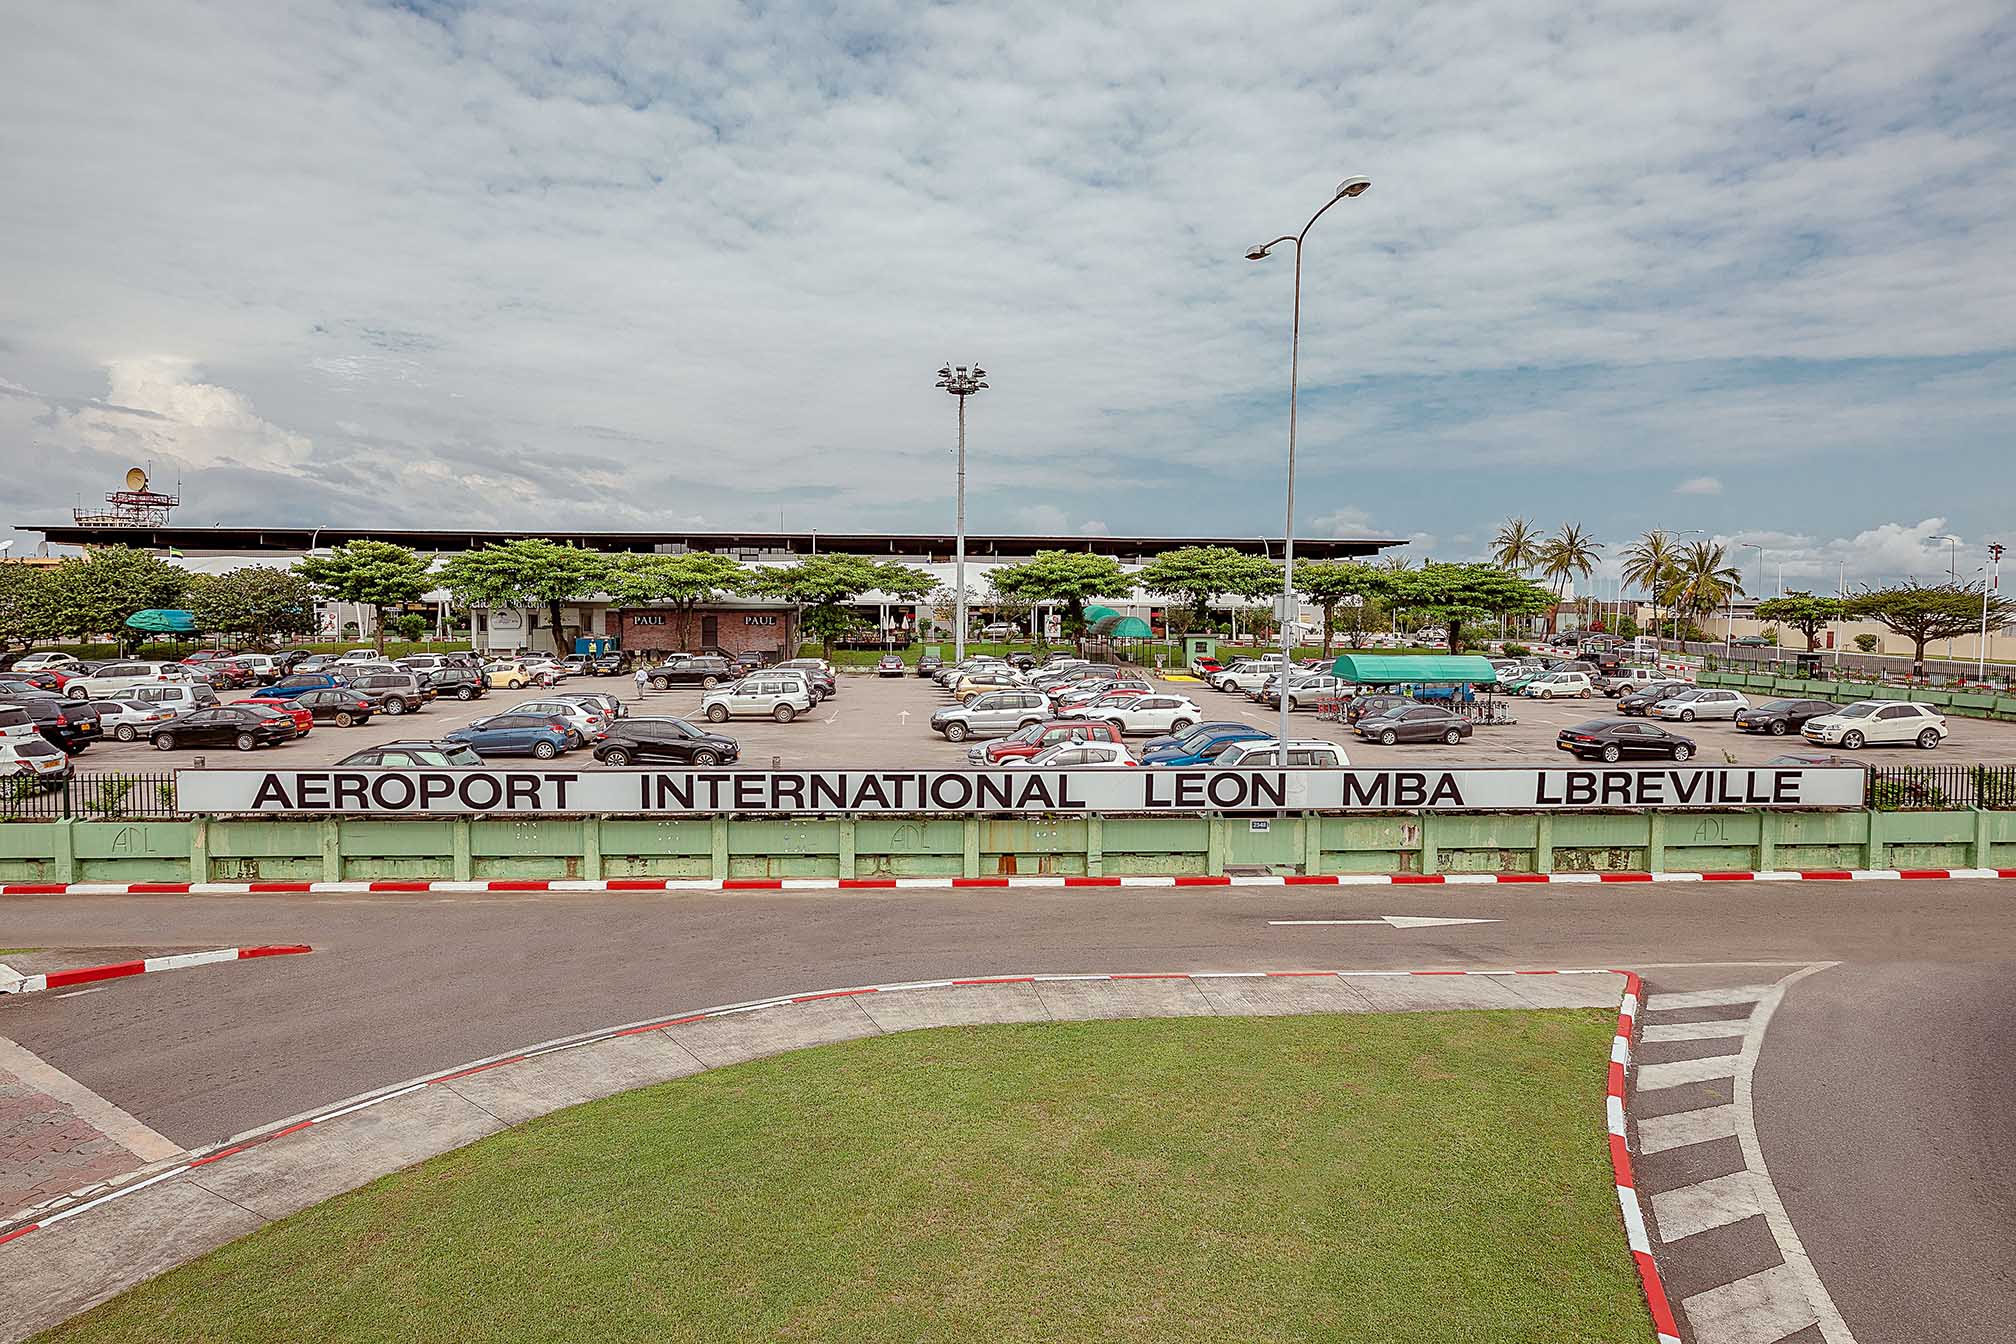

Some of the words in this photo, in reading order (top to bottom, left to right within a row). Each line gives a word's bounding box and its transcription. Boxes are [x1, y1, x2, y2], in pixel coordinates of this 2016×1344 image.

[634, 616, 665, 625] PAUL
[745, 616, 776, 625] PAUL
[251, 773, 577, 809] AEROPORT
[641, 774, 1085, 809] INTERNATIONAL
[1145, 773, 1286, 807] LEON
[1343, 773, 1464, 805] MBA
[1536, 771, 1802, 804] LBREVILLE
[1694, 817, 1729, 842] ADL
